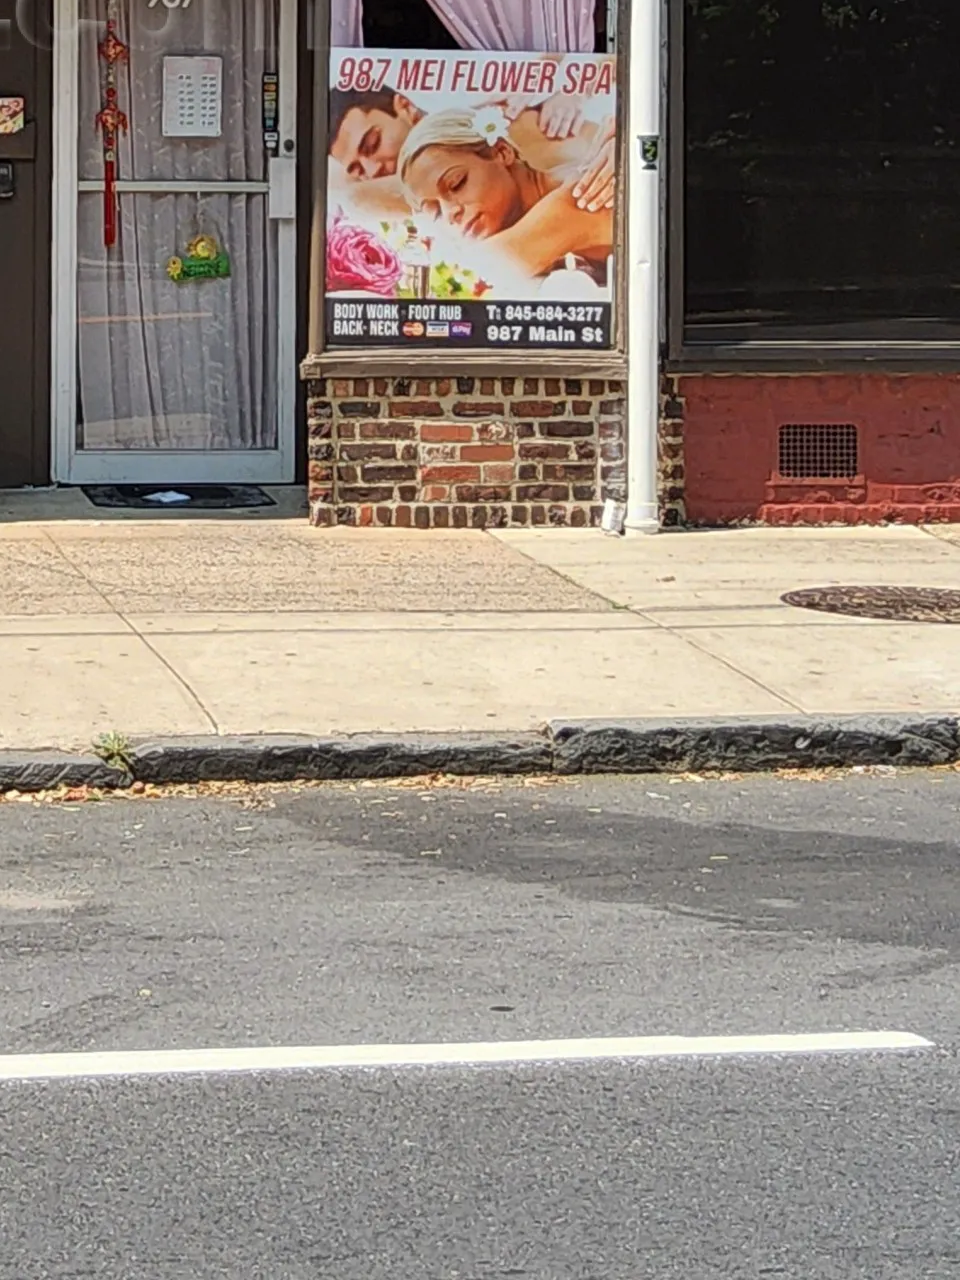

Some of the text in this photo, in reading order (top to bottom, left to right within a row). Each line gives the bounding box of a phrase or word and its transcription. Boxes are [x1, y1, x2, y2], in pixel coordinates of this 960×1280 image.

[338, 56, 612, 95] 987 MEI FLOWER SPA
[334, 304, 363, 319] BODY
[366, 305, 399, 319] WORK
[408, 305, 436, 320] FOOT
[439, 306, 462, 320] RUB
[487, 305, 603, 322] T: 845-684-3277
[370, 321, 399, 336] NECK
[487, 327, 521, 341] 987
[529, 326, 575, 342] Main
[581, 327, 603, 342] St
